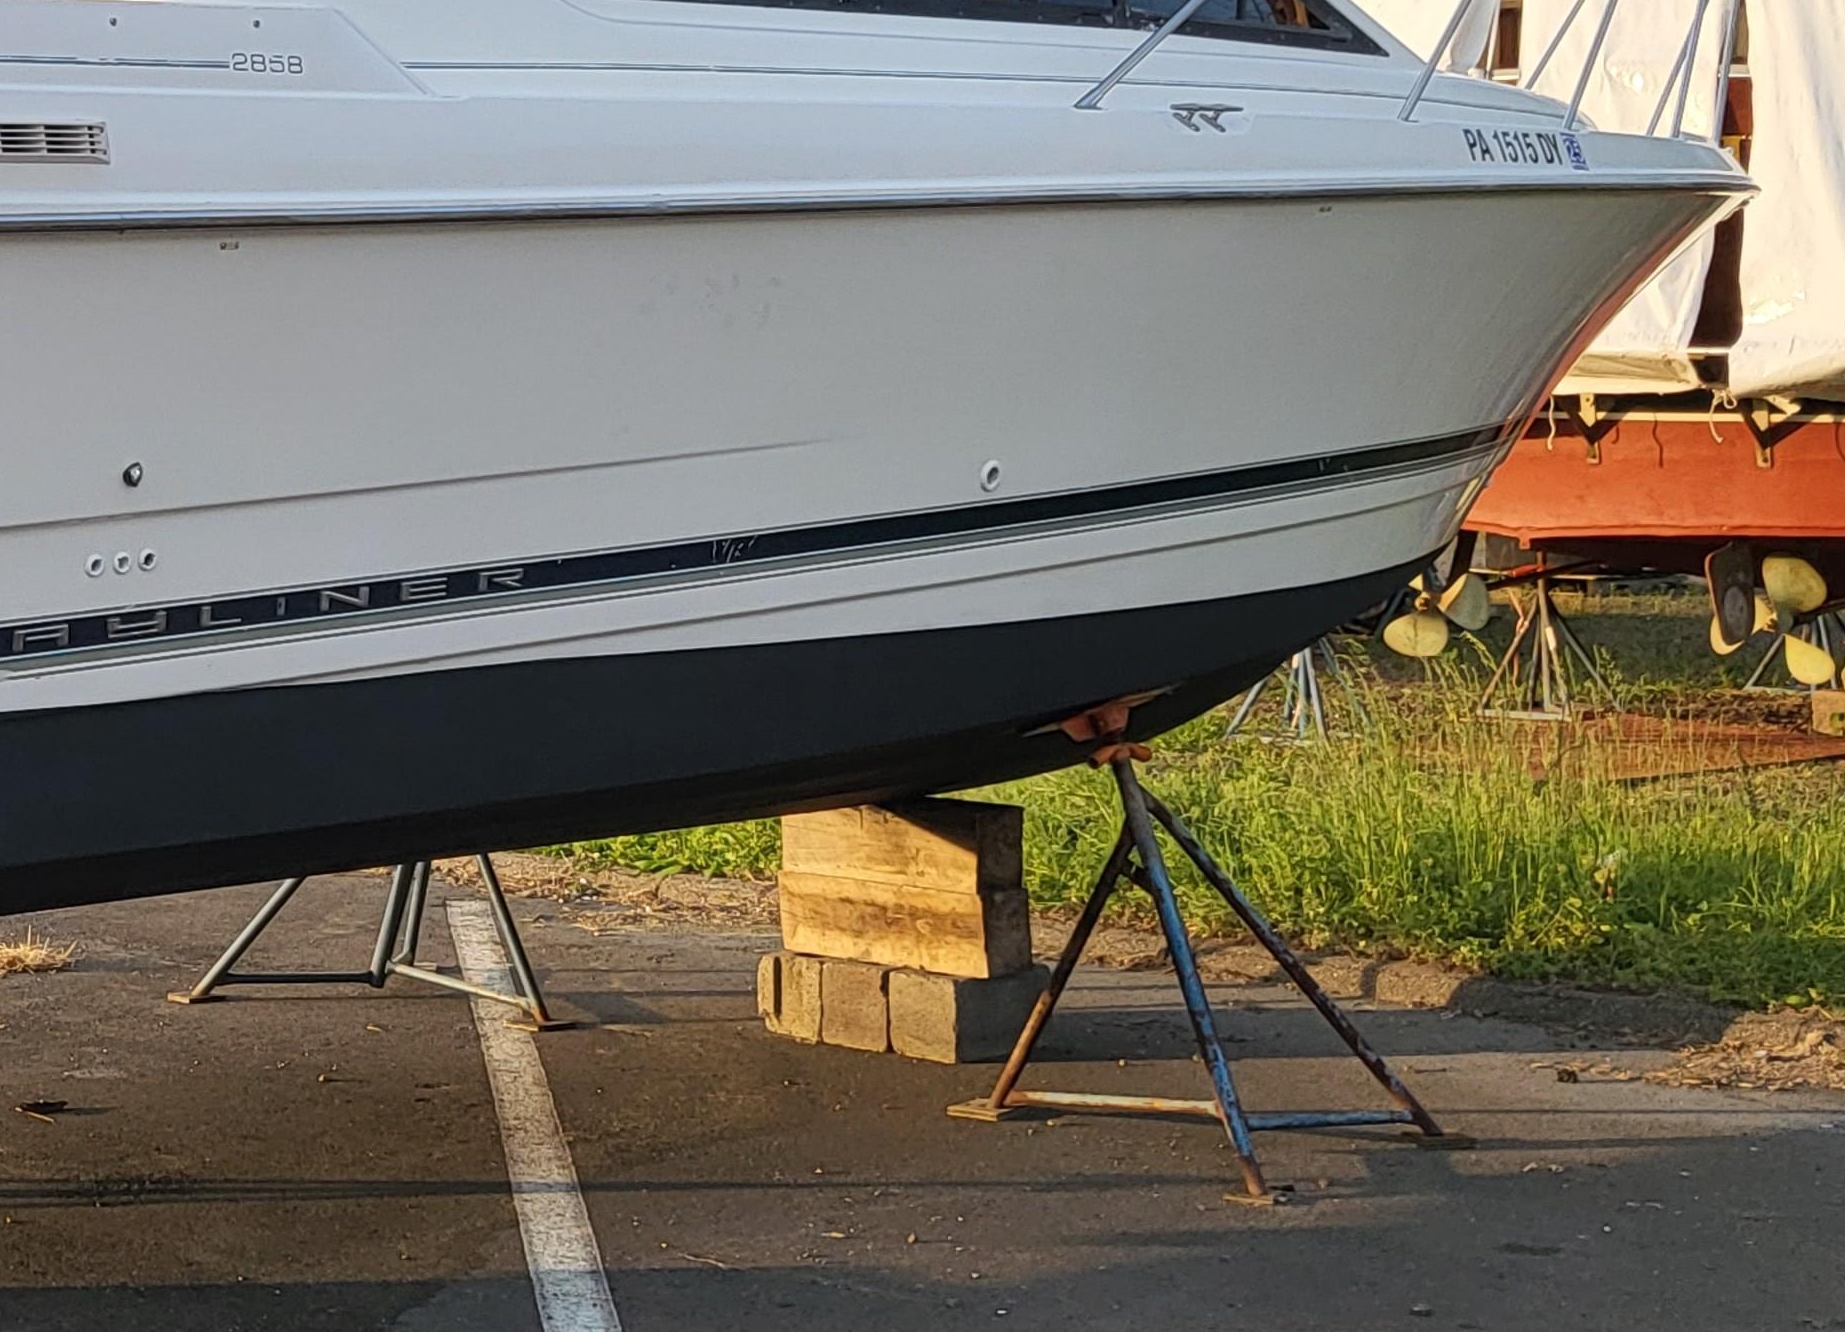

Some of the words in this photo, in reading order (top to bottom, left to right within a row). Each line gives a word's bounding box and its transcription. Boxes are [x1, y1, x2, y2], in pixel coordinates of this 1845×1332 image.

[231, 52, 303, 74] 2858
[1462, 128, 1495, 162] PA
[1492, 129, 1539, 164] 1515
[1535, 132, 1563, 166] DY
